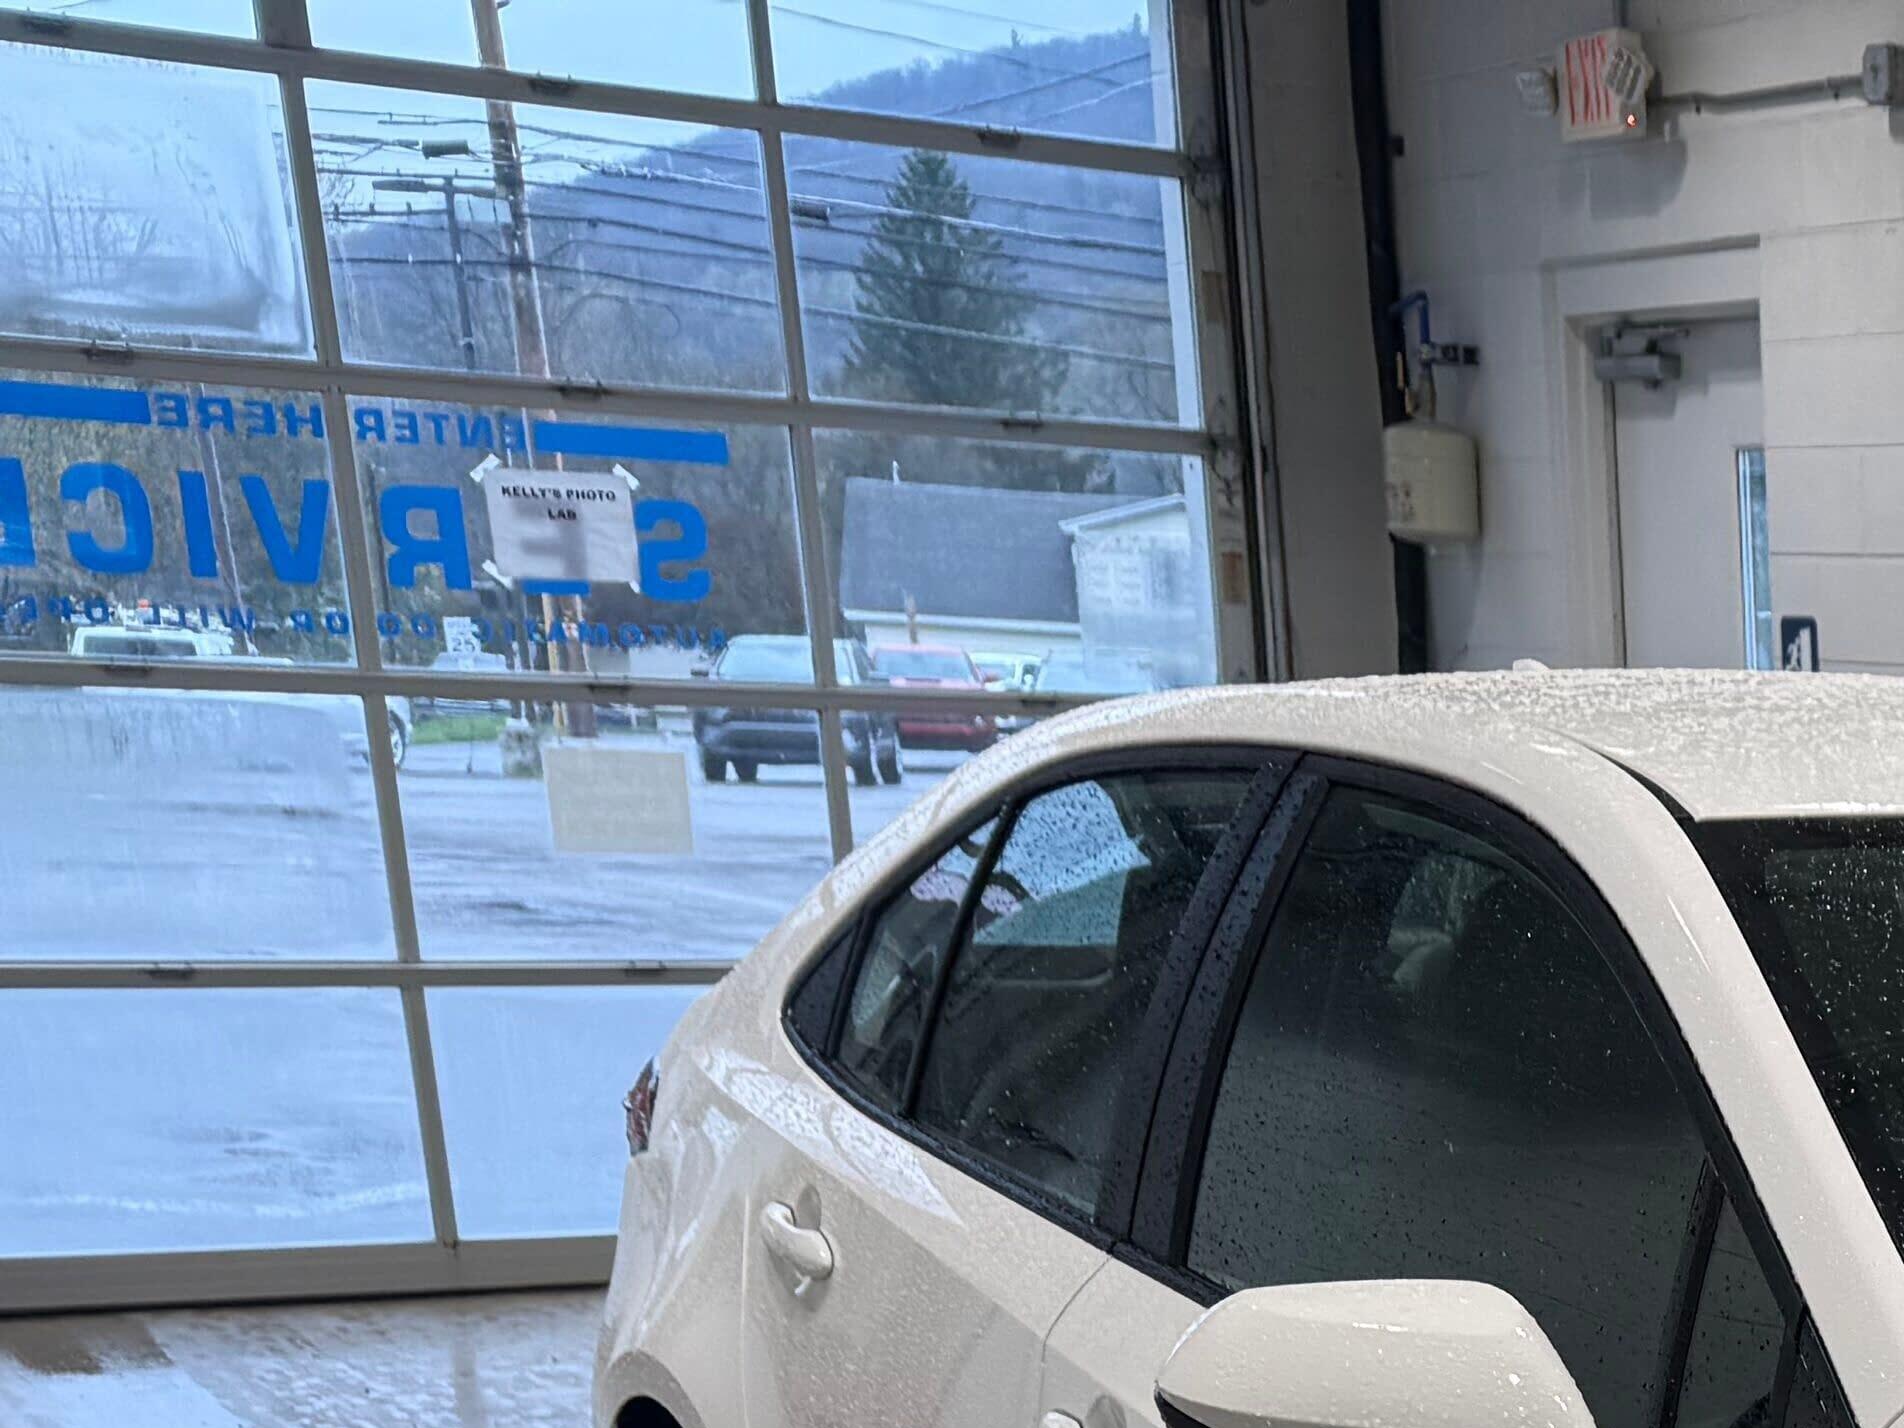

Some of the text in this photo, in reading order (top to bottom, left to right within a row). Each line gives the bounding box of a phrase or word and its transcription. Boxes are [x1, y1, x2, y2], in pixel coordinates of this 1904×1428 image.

[501, 485, 617, 501] KELLY'S PHOTO
[547, 508, 577, 521] LAB
[451, 637, 476, 652] 25
